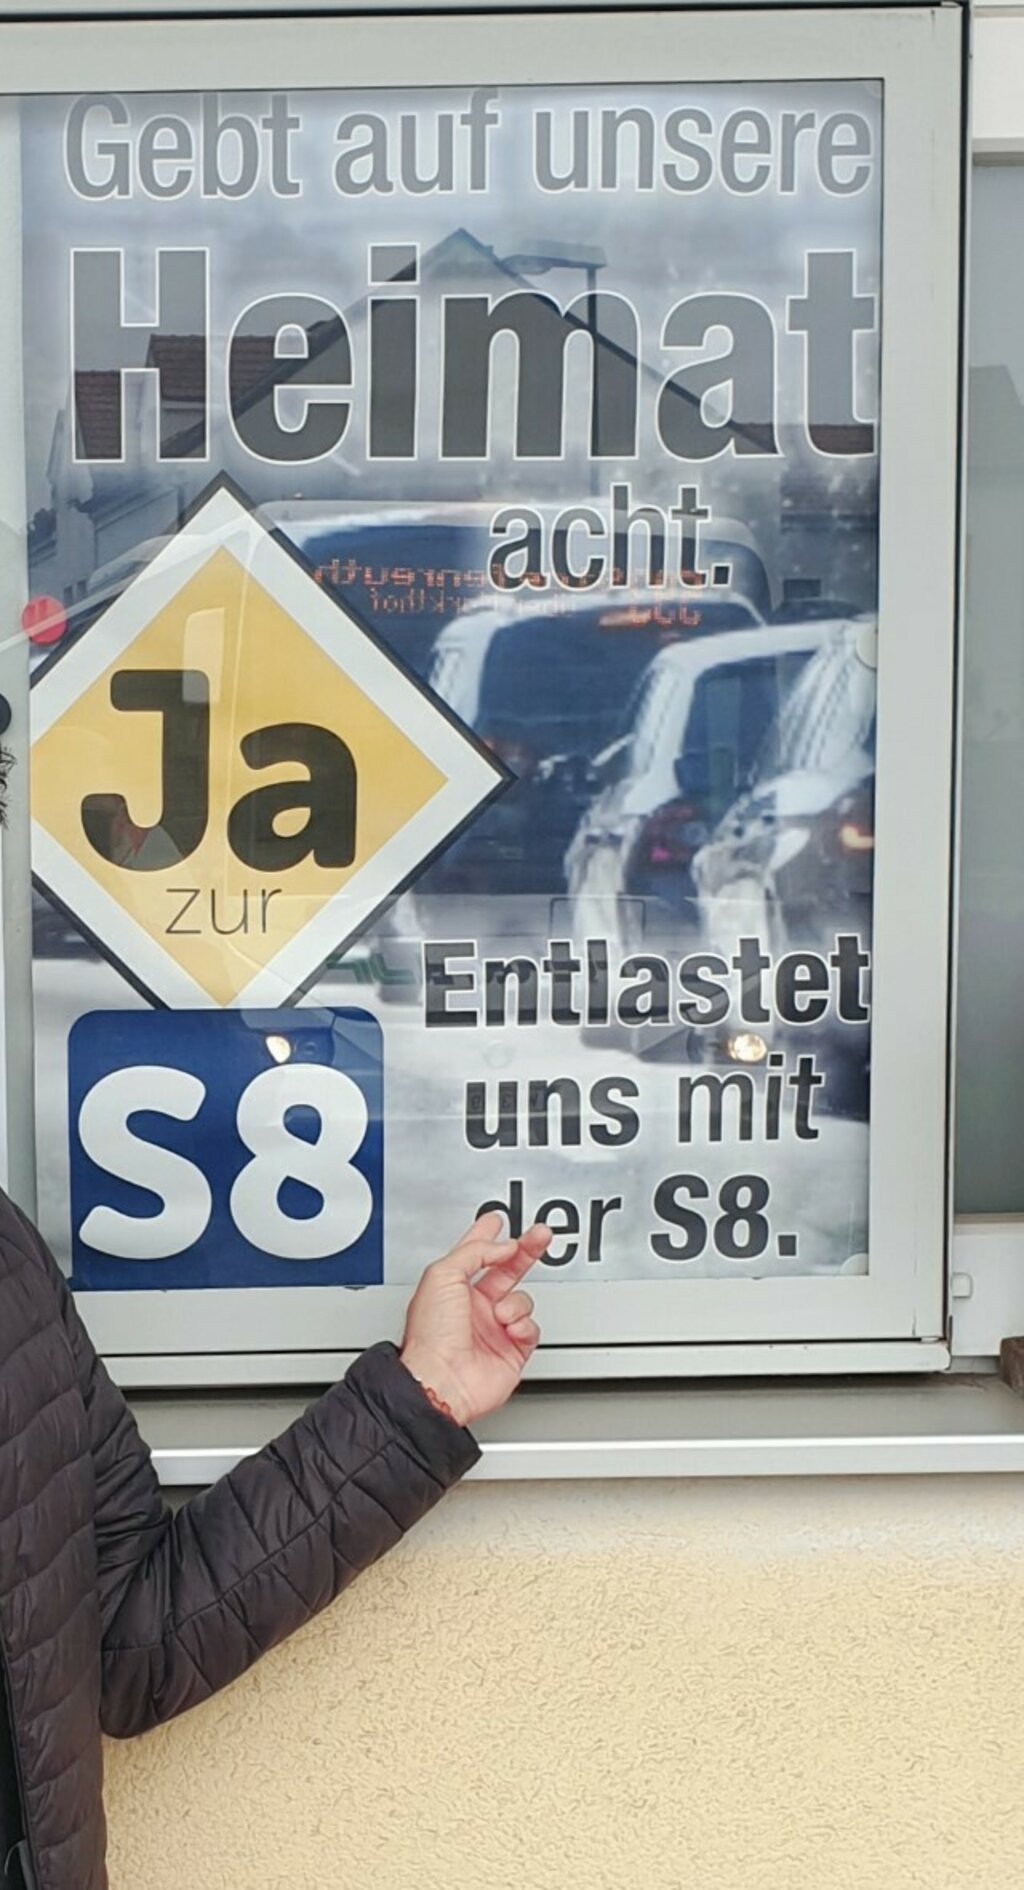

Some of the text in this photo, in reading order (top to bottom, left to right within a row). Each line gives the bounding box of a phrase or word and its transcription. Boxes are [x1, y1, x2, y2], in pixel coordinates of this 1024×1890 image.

[64, 88, 874, 200] Gebt auf unsere
[70, 242, 877, 465] Heimat
[488, 483, 732, 592] acht.
[81, 669, 358, 871] Ja
[165, 886, 283, 934] zur
[422, 933, 870, 1028] Entlastet
[464, 1054, 823, 1151] uns mit
[78, 1064, 373, 1260] S8
[475, 1174, 797, 1267] der S8.
